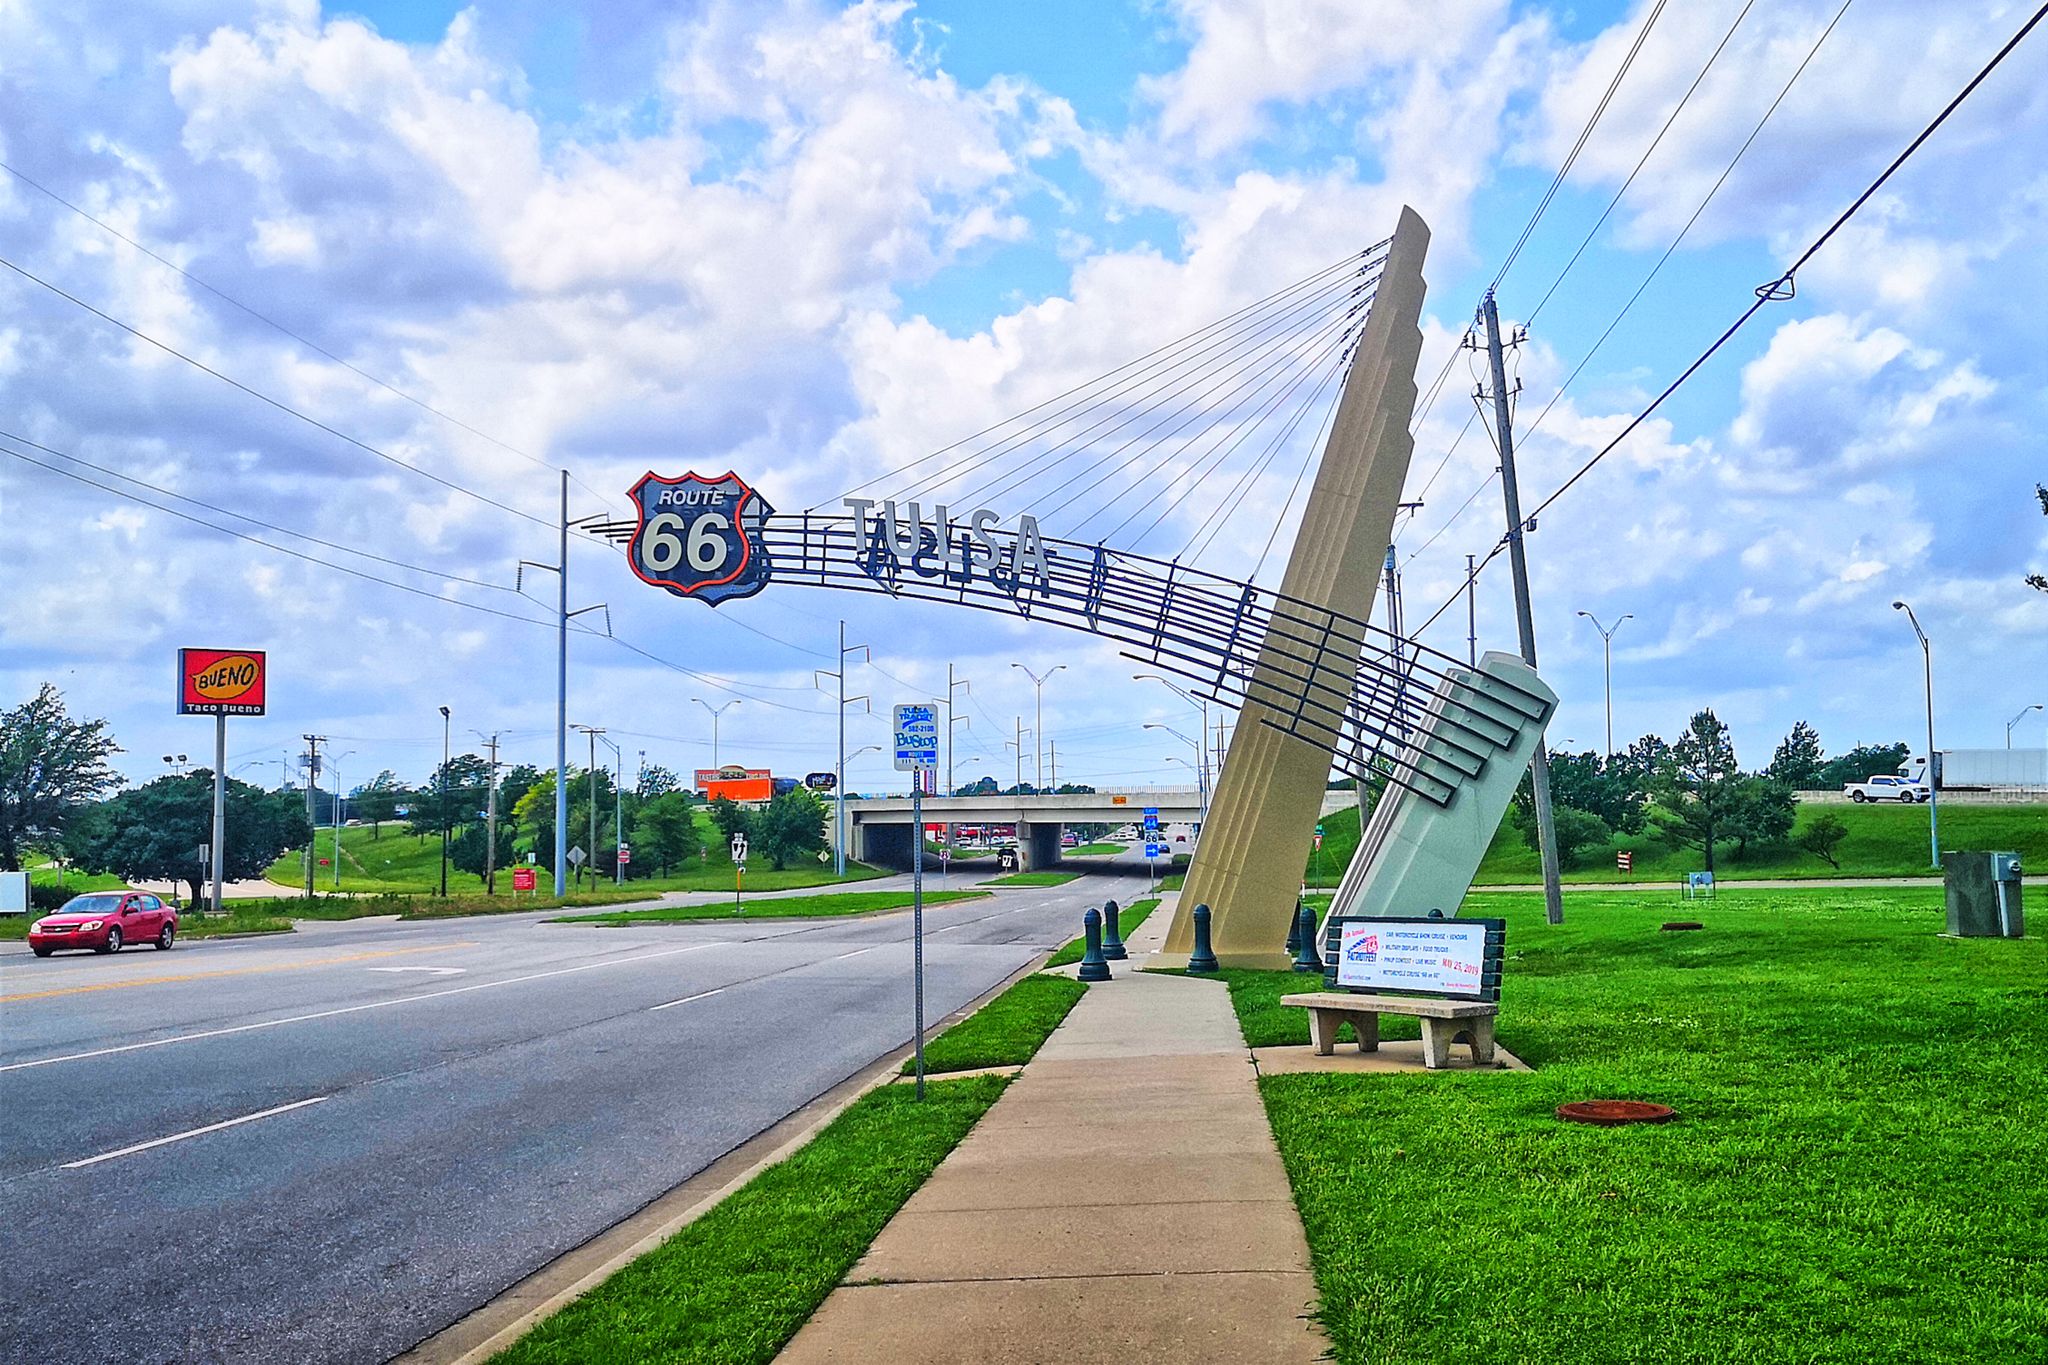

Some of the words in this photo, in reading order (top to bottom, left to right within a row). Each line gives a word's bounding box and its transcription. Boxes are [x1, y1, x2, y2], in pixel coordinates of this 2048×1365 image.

[659, 490, 724, 505] ROUTE
[641, 512, 729, 572] 66
[843, 497, 1050, 580] TULSA
[198, 662, 255, 689] BUENO
[187, 703, 218, 712] Taco
[222, 703, 261, 713] Bueno
[1146, 820, 1156, 828] 44
[1146, 833, 1157, 843] 66
[1464, 963, 1479, 976] 2019
